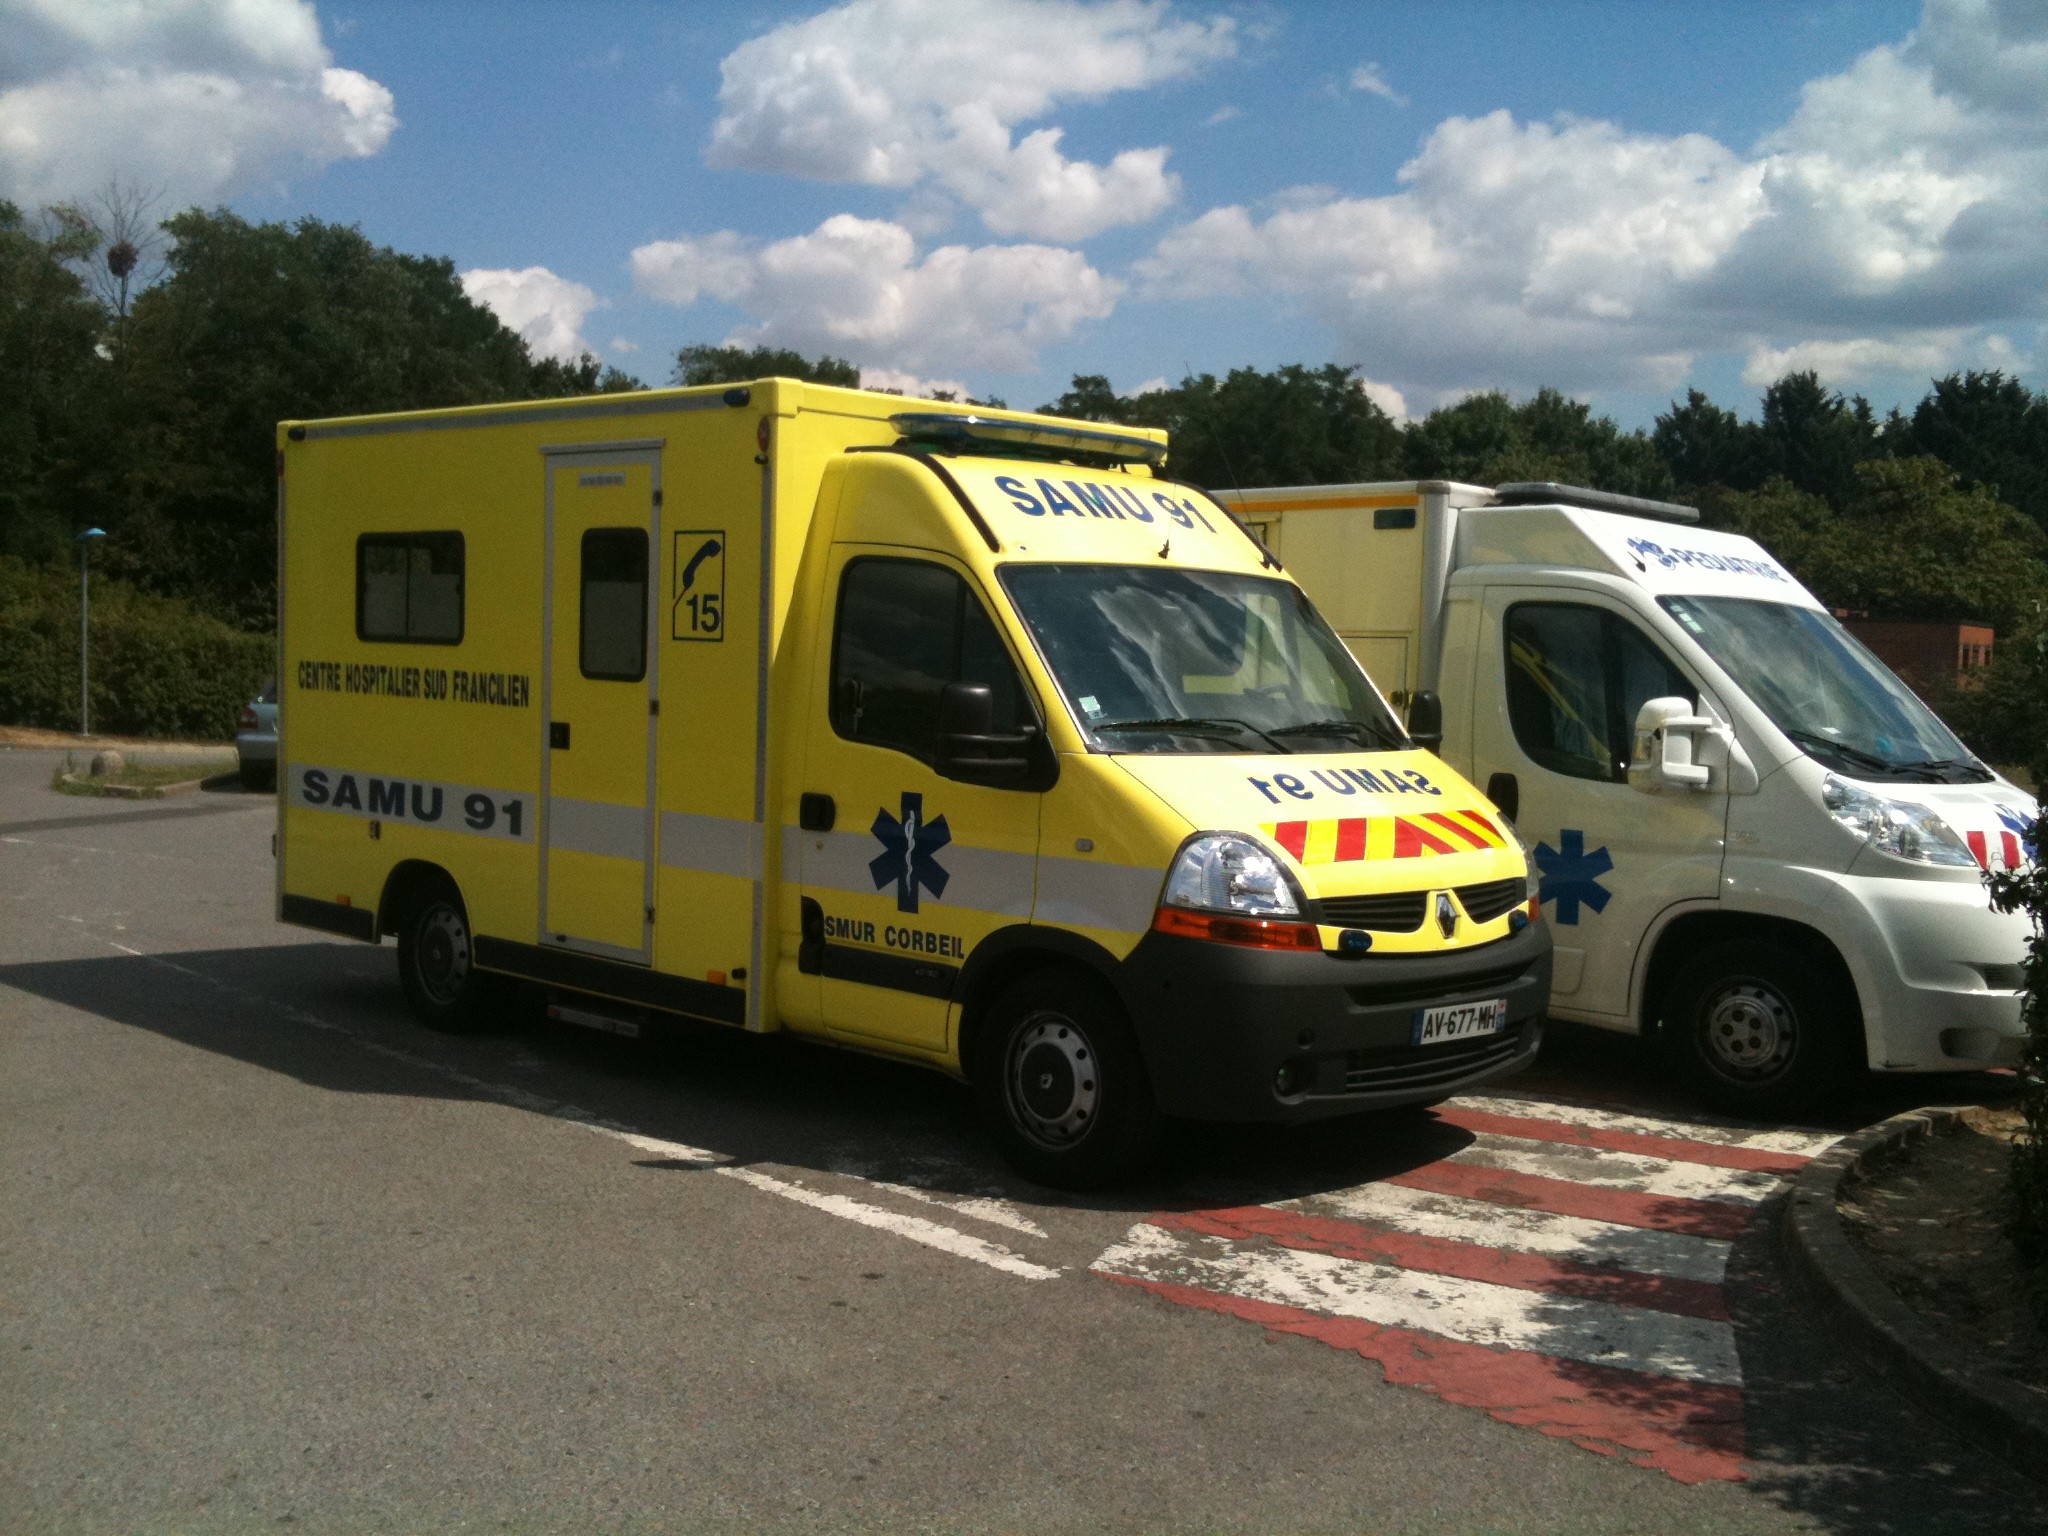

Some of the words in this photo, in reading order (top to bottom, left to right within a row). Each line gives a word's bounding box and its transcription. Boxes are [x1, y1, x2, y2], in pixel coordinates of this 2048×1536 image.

[995, 476, 1154, 523] SAMU
[1152, 492, 1217, 534] 91
[687, 594, 720, 633] 15
[299, 661, 341, 692] CENTRE
[346, 663, 421, 699] HOSPITALIER
[424, 668, 448, 700] SUD
[453, 670, 529, 707] FRANCILIEN
[303, 769, 443, 823] SAMU
[464, 793, 523, 837] 91
[824, 916, 876, 943] SMUR
[885, 926, 965, 960] CORBEIL
[1423, 1004, 1497, 1039] AV-677-MH
